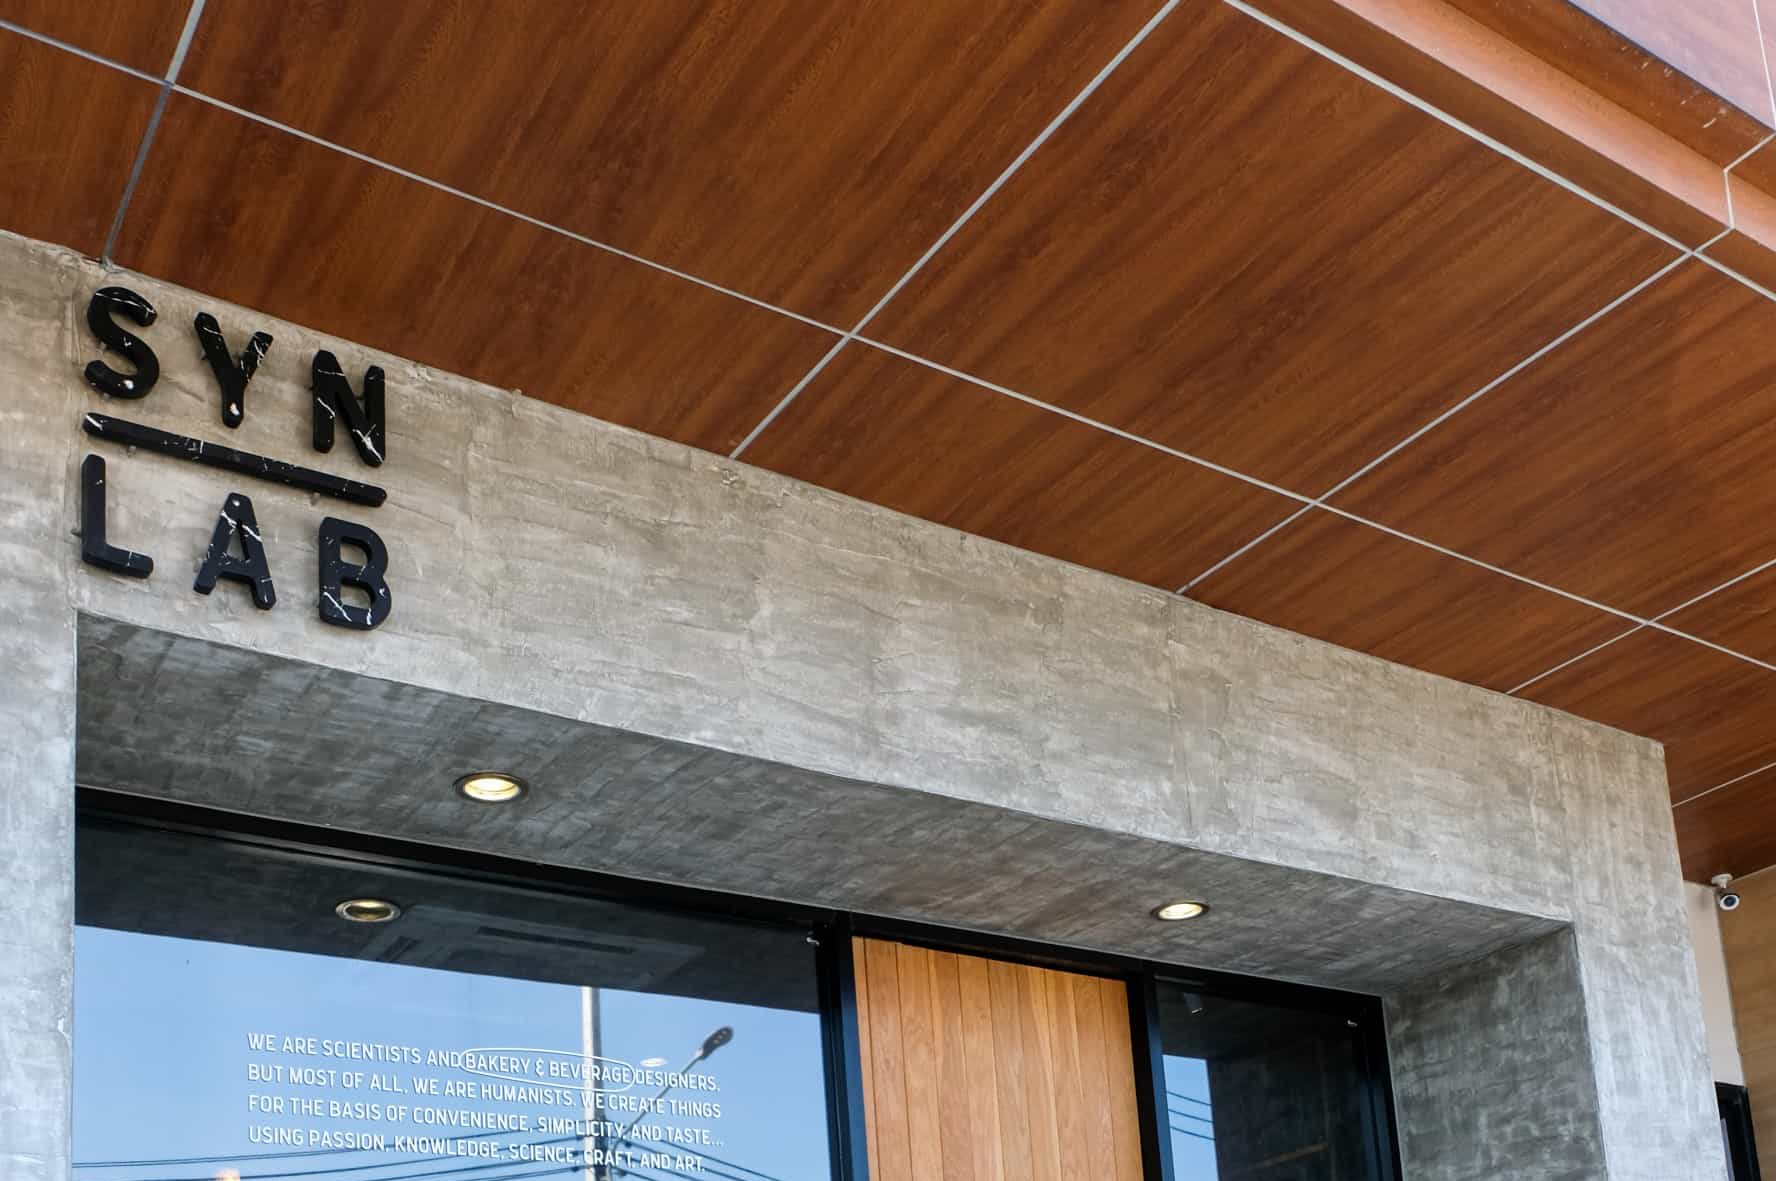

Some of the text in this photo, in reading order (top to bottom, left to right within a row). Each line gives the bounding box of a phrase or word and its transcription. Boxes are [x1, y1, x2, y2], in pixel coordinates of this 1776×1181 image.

[84, 286, 386, 468] SYN
[81, 454, 392, 631] LAB
[247, 1032, 276, 1051] WE
[282, 1037, 317, 1055] ARE
[322, 1040, 421, 1064] SCIENTISTS
[426, 1049, 462, 1069] AND
[465, 1052, 530, 1074] BAKERY
[549, 1060, 631, 1084] BEVERAGE
[248, 1064, 283, 1082] BUT
[289, 1068, 336, 1088] MOST
[342, 1072, 364, 1090] OF
[412, 1077, 439, 1096] WE
[444, 1081, 477, 1099] ARE
[581, 1092, 605, 1109] WE
[608, 1094, 666, 1115] CREATE
[670, 1099, 721, 1119] THINGS
[248, 1095, 284, 1114] FOR
[289, 1097, 324, 1116] THE
[329, 1101, 381, 1120] BASIS
[386, 1104, 408, 1122] OF
[631, 1124, 662, 1142] AND
[249, 1126, 304, 1146] USING
[640, 1152, 671, 1170] AND
